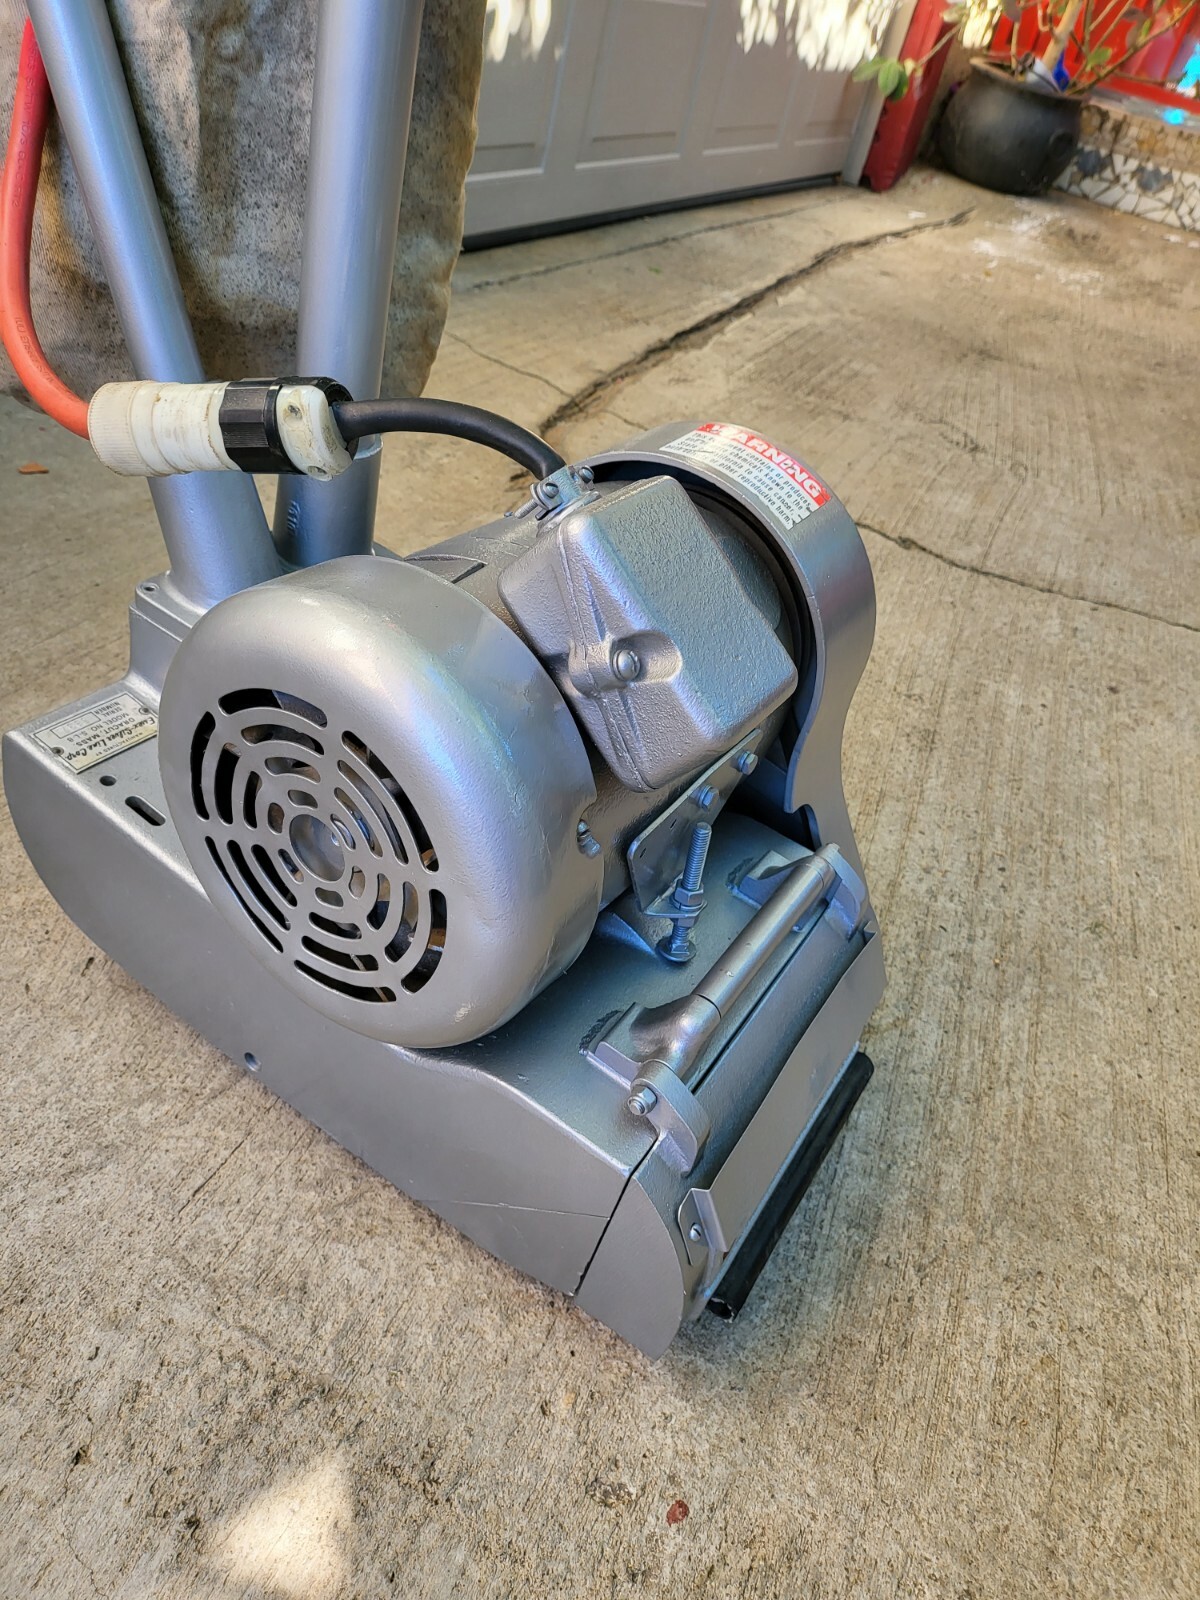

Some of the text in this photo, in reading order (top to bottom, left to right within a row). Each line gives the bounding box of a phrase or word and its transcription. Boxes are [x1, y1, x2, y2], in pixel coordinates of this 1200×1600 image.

[676, 440, 698, 449] State
[753, 475, 774, 492] cause
[746, 451, 775, 473] contains
[775, 472, 784, 480] or
[719, 462, 738, 475] other
[738, 473, 776, 506] reproductive
[729, 451, 763, 473] chemicals
[764, 473, 785, 491] known
[785, 490, 793, 499] to
[793, 498, 804, 511] the
[94, 701, 120, 714] NUMBER
[102, 707, 123, 718] SERIAL
[101, 717, 135, 734] DRACUT,
[103, 711, 129, 726] MODEL
[91, 739, 107, 750] Line
